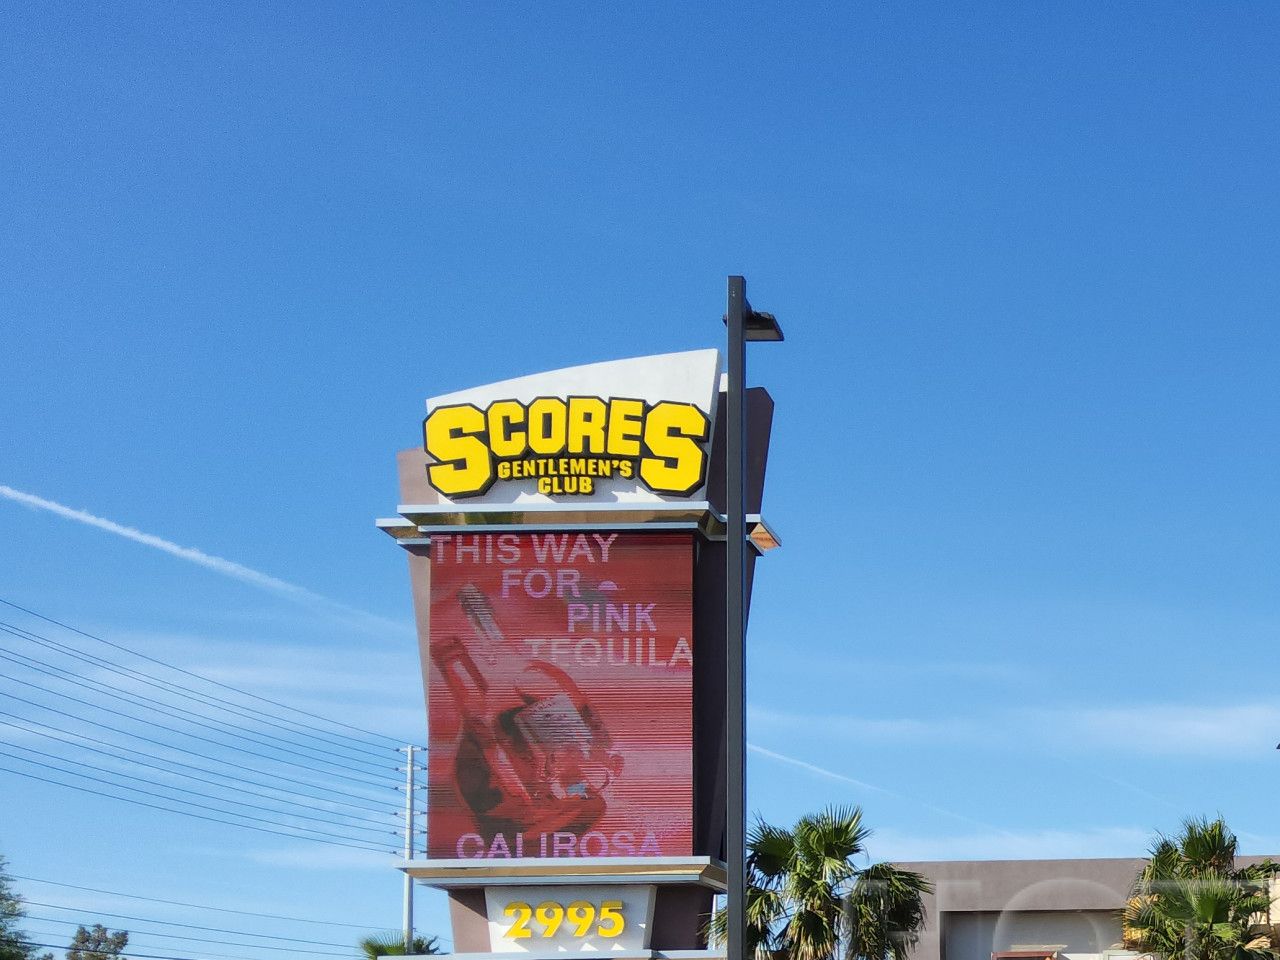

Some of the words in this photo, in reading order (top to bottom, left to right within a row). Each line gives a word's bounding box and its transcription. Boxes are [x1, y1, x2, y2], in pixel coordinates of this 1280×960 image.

[424, 396, 710, 498] SCORES
[497, 458, 633, 481] GENTLEMEN'S
[537, 476, 594, 495] CLUB
[430, 534, 521, 564] THIS
[531, 533, 618, 563] WAY
[500, 568, 582, 598] FOR
[567, 603, 657, 632] PINK
[522, 637, 692, 667] TEQUILA
[456, 831, 662, 858] CALIROSA
[503, 900, 625, 938] 2995
